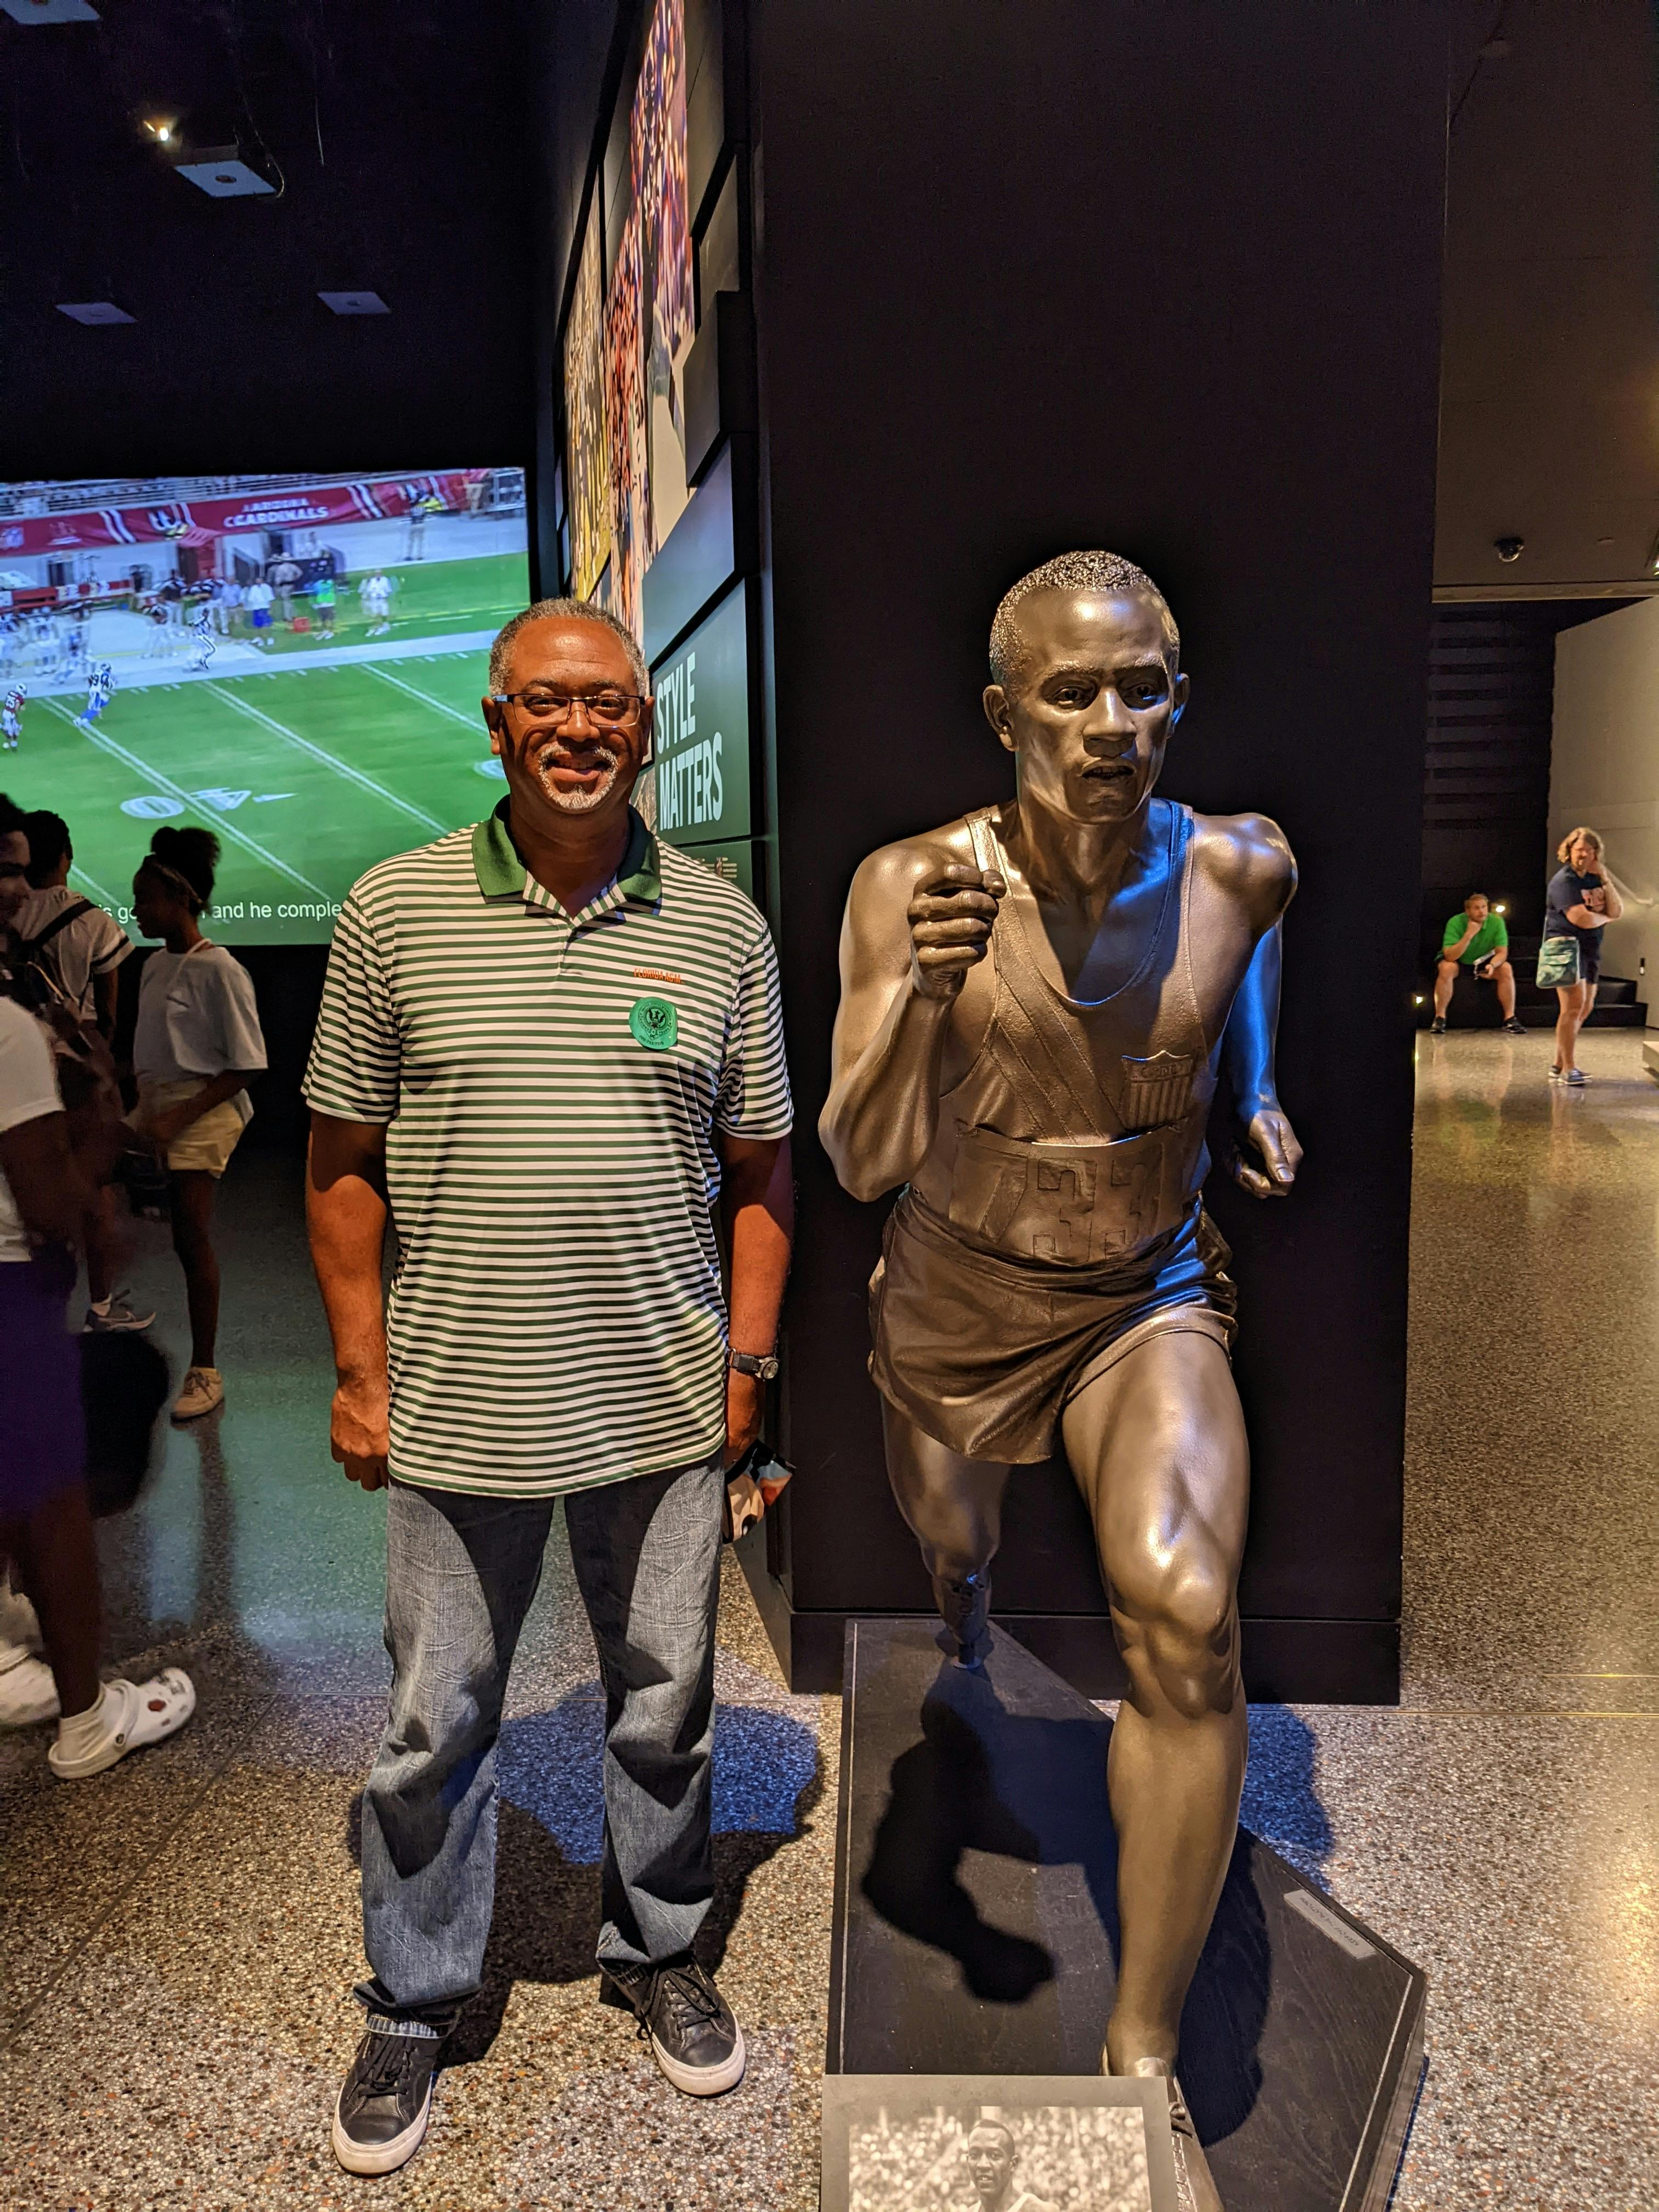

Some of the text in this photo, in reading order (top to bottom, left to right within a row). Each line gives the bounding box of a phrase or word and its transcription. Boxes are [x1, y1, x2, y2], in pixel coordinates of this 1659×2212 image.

[657, 652, 696, 754] STYLE
[659, 732, 723, 831] MATTERS
[212, 902, 244, 918] and
[250, 902, 272, 918] he
[633, 968, 664, 980] FLORIDA
